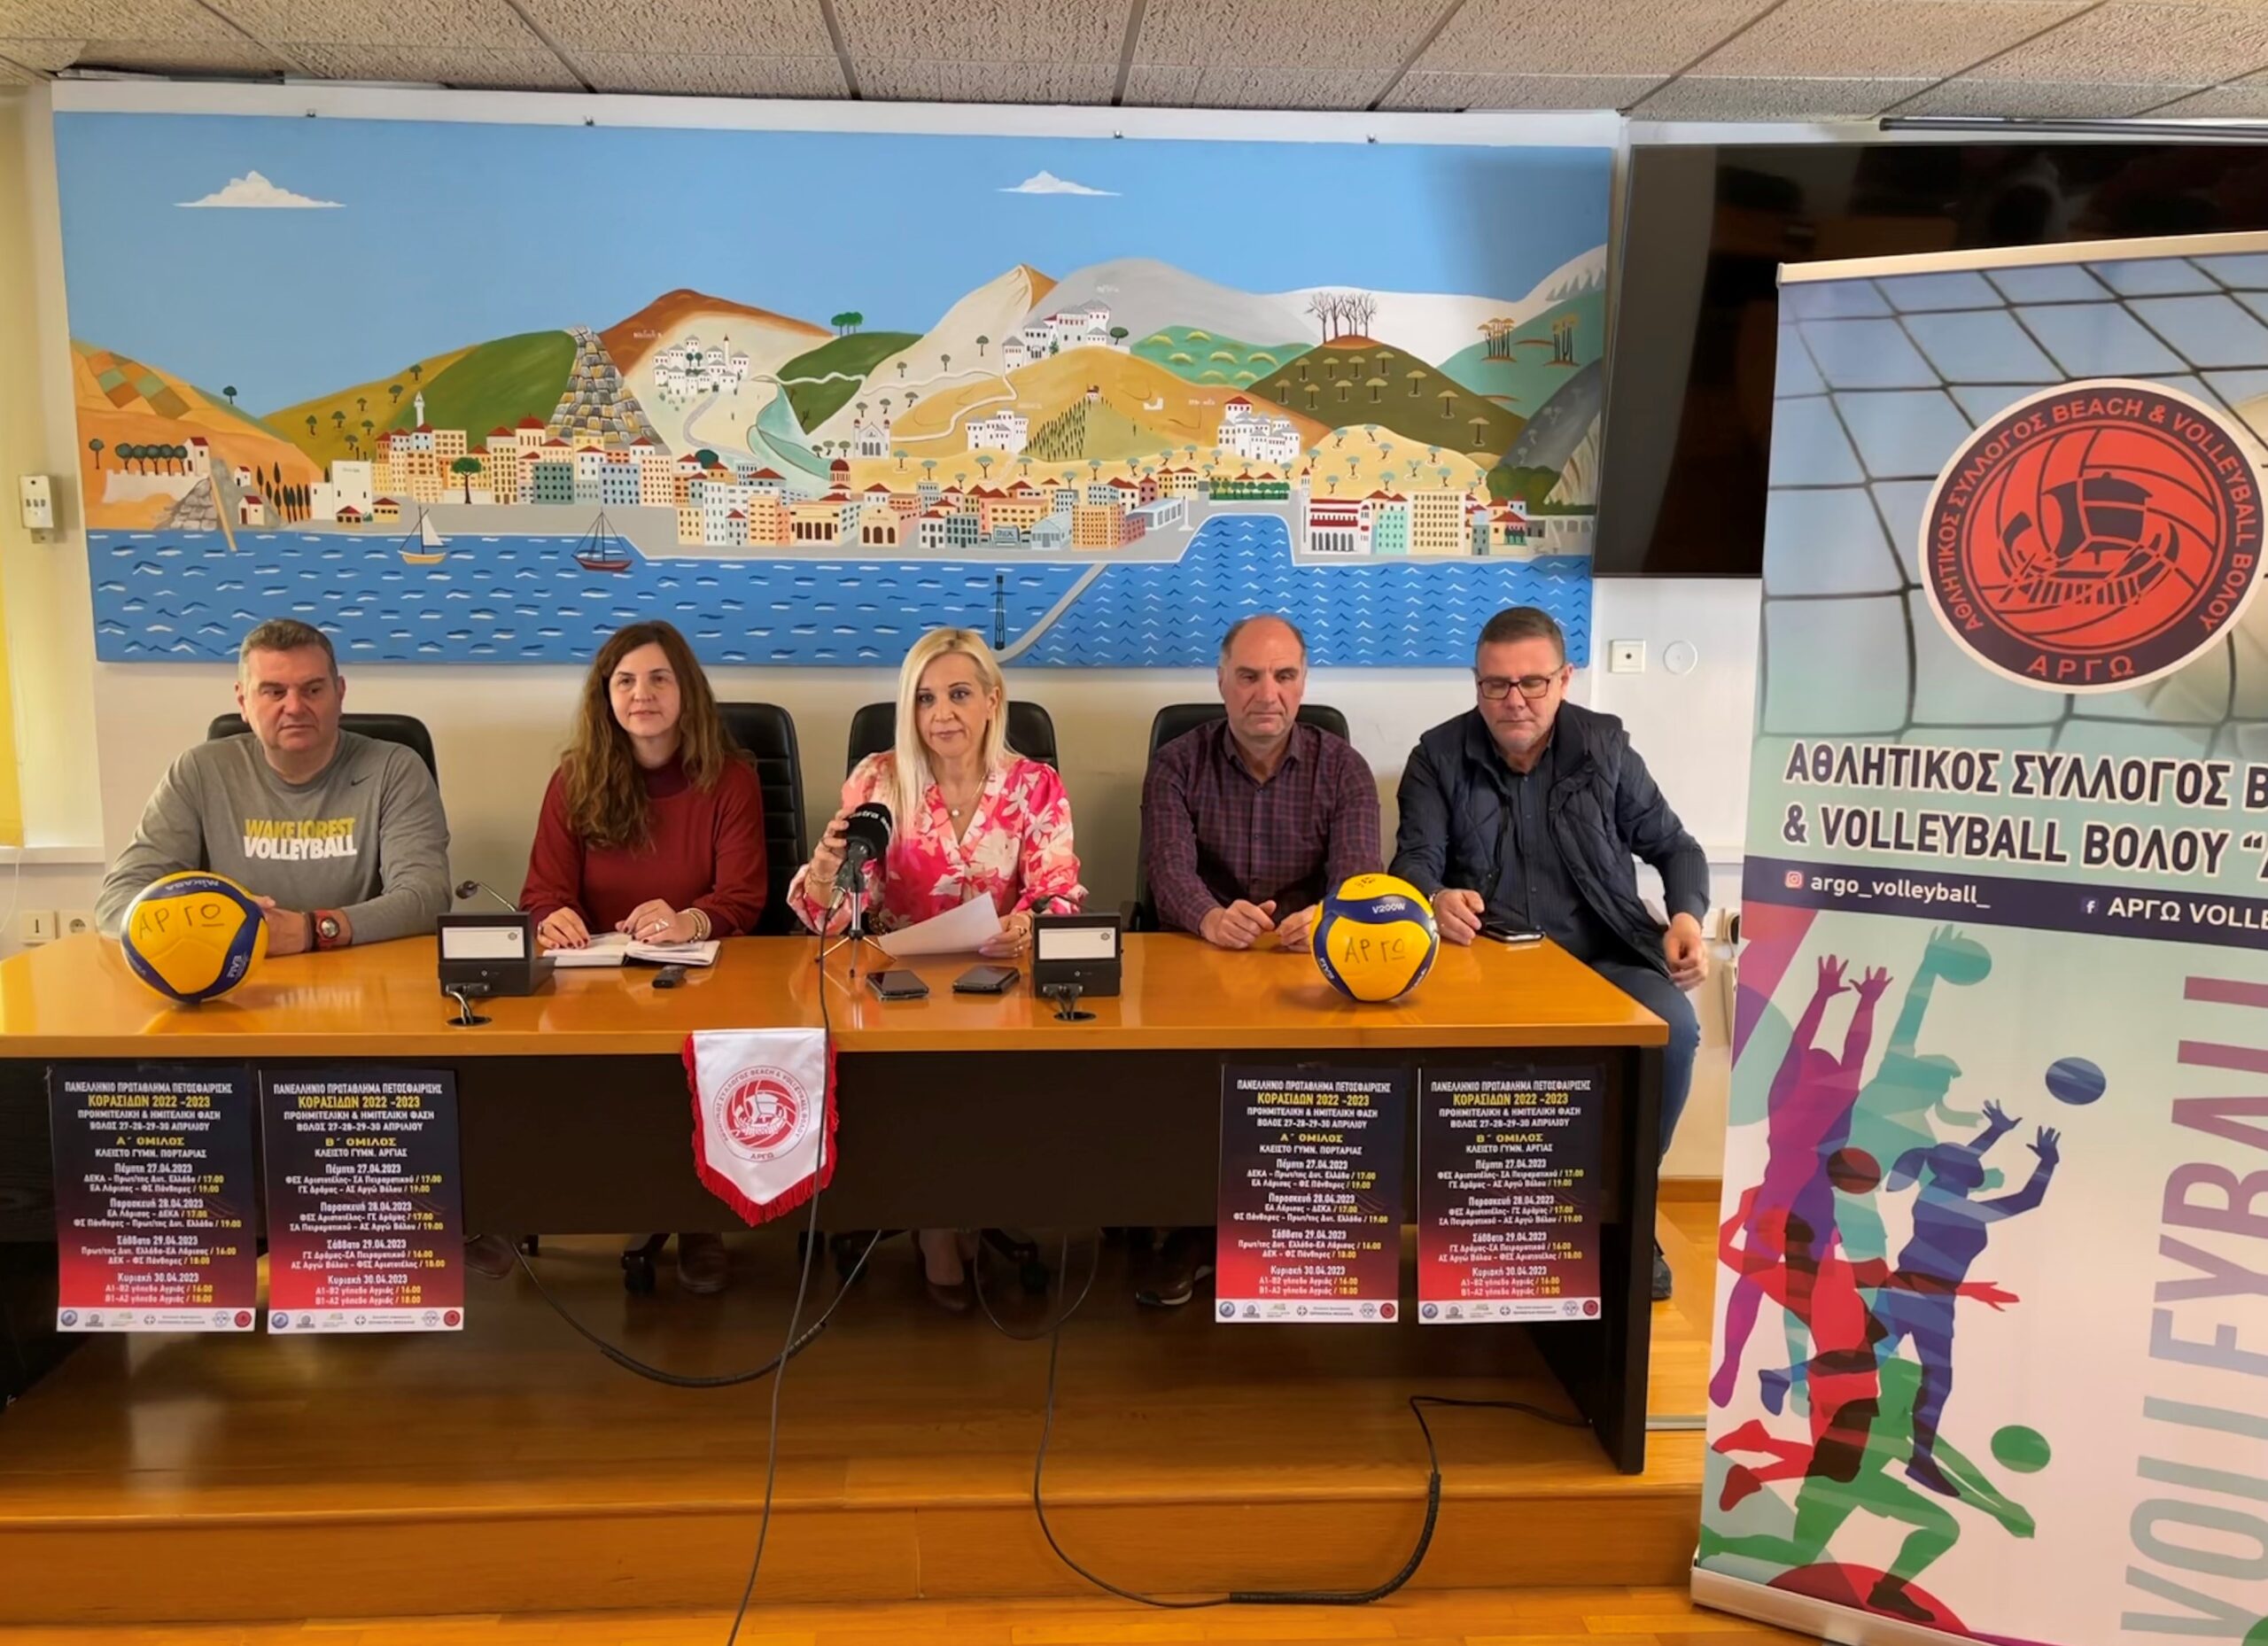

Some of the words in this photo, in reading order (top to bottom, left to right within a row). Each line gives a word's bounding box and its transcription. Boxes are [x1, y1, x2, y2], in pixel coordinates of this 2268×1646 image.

[2052, 397, 2144, 423] BEACH
[2148, 404, 2167, 423] &
[1951, 412, 2047, 507] ΣΥΛΛΟΓΟΣ
[2171, 414, 2256, 547] VOLLEYBALL
[1938, 512, 1984, 631] ΑΘΛΗΤΙΚΟΣ
[2199, 553, 2252, 632] ΒΟΛΟΥ
[2026, 655, 2135, 679] ΑΡΓΩ
[1785, 742, 2000, 793] ΑΘΛΗΤΙΚΟΣ
[2011, 755, 2231, 806] ΣΥΛΛΟΓΟΣ
[244, 819, 296, 838] WAKE
[1783, 804, 1807, 842] &
[1821, 807, 2067, 863] VOLLEYBALL
[2084, 824, 2229, 873] ΒΟΛΟΥ
[243, 835, 358, 861] VOLLEYBALL
[1811, 876, 1991, 909] argo_volleyball_
[1371, 903, 1405, 914] V200W
[2108, 897, 2181, 921] ΑΡΓΩ
[89, 1095, 149, 1106] ΚΟΡΑΣΙΔΩΝ
[152, 1096, 177, 1106] 2022
[298, 1097, 359, 1108] ΚΟΡΑΣΙΔΩΝ
[362, 1097, 386, 1107] 2022
[1258, 1093, 1313, 1105] ΚΟΡΑΣΙΔΩΝ
[1317, 1094, 1339, 1105] 2022
[1453, 1094, 1511, 1106] ΚΟΡΑΣΙΔΩΝ
[1514, 1094, 1536, 1106] 2022
[1314, 1108, 1355, 1117] ΗΜΙΤΕΛΙΚΗ
[1356, 1109, 1378, 1118] ΦΑΣΗ
[1511, 1107, 1556, 1116] ΗΜΙΤΕΛΙΚΗ
[346, 1137, 396, 1146] ΟΜΙΛΟΣ
[1299, 1134, 1343, 1143] ΟΜΙΛΟΣ
[1496, 1133, 1543, 1142] ΟΜΙΛΟΣ
[160, 1149, 206, 1158] ΠΟΡΤΑΡΙΑΣ
[1319, 1145, 1362, 1155] ΠΟΡΤΑΡΙΑΣ
[147, 1163, 192, 1173] 27.04.2023
[357, 1164, 401, 1173] 27.04.2023
[1306, 1160, 1348, 1169] 27.04.2023
[1504, 1159, 1547, 1169] 27.04.2023
[159, 1199, 204, 1207] 28.04.2023
[1313, 1194, 1355, 1203] 28.04.2023
[1513, 1195, 1554, 1205] 28.04.2023
[369, 1202, 412, 1211] 28.04.2023
[1305, 1230, 1347, 1239] 29.04.2023
[1506, 1232, 1546, 1241] 29.04.2023
[152, 1236, 198, 1245] 29.04.2023
[362, 1239, 406, 1249] 29.04.2023
[1304, 1266, 1345, 1275] 30.04.2023
[1506, 1267, 1547, 1276] 30.04.2023
[155, 1273, 198, 1283] 30.04.2023
[363, 1275, 408, 1284] 30.04.2023
